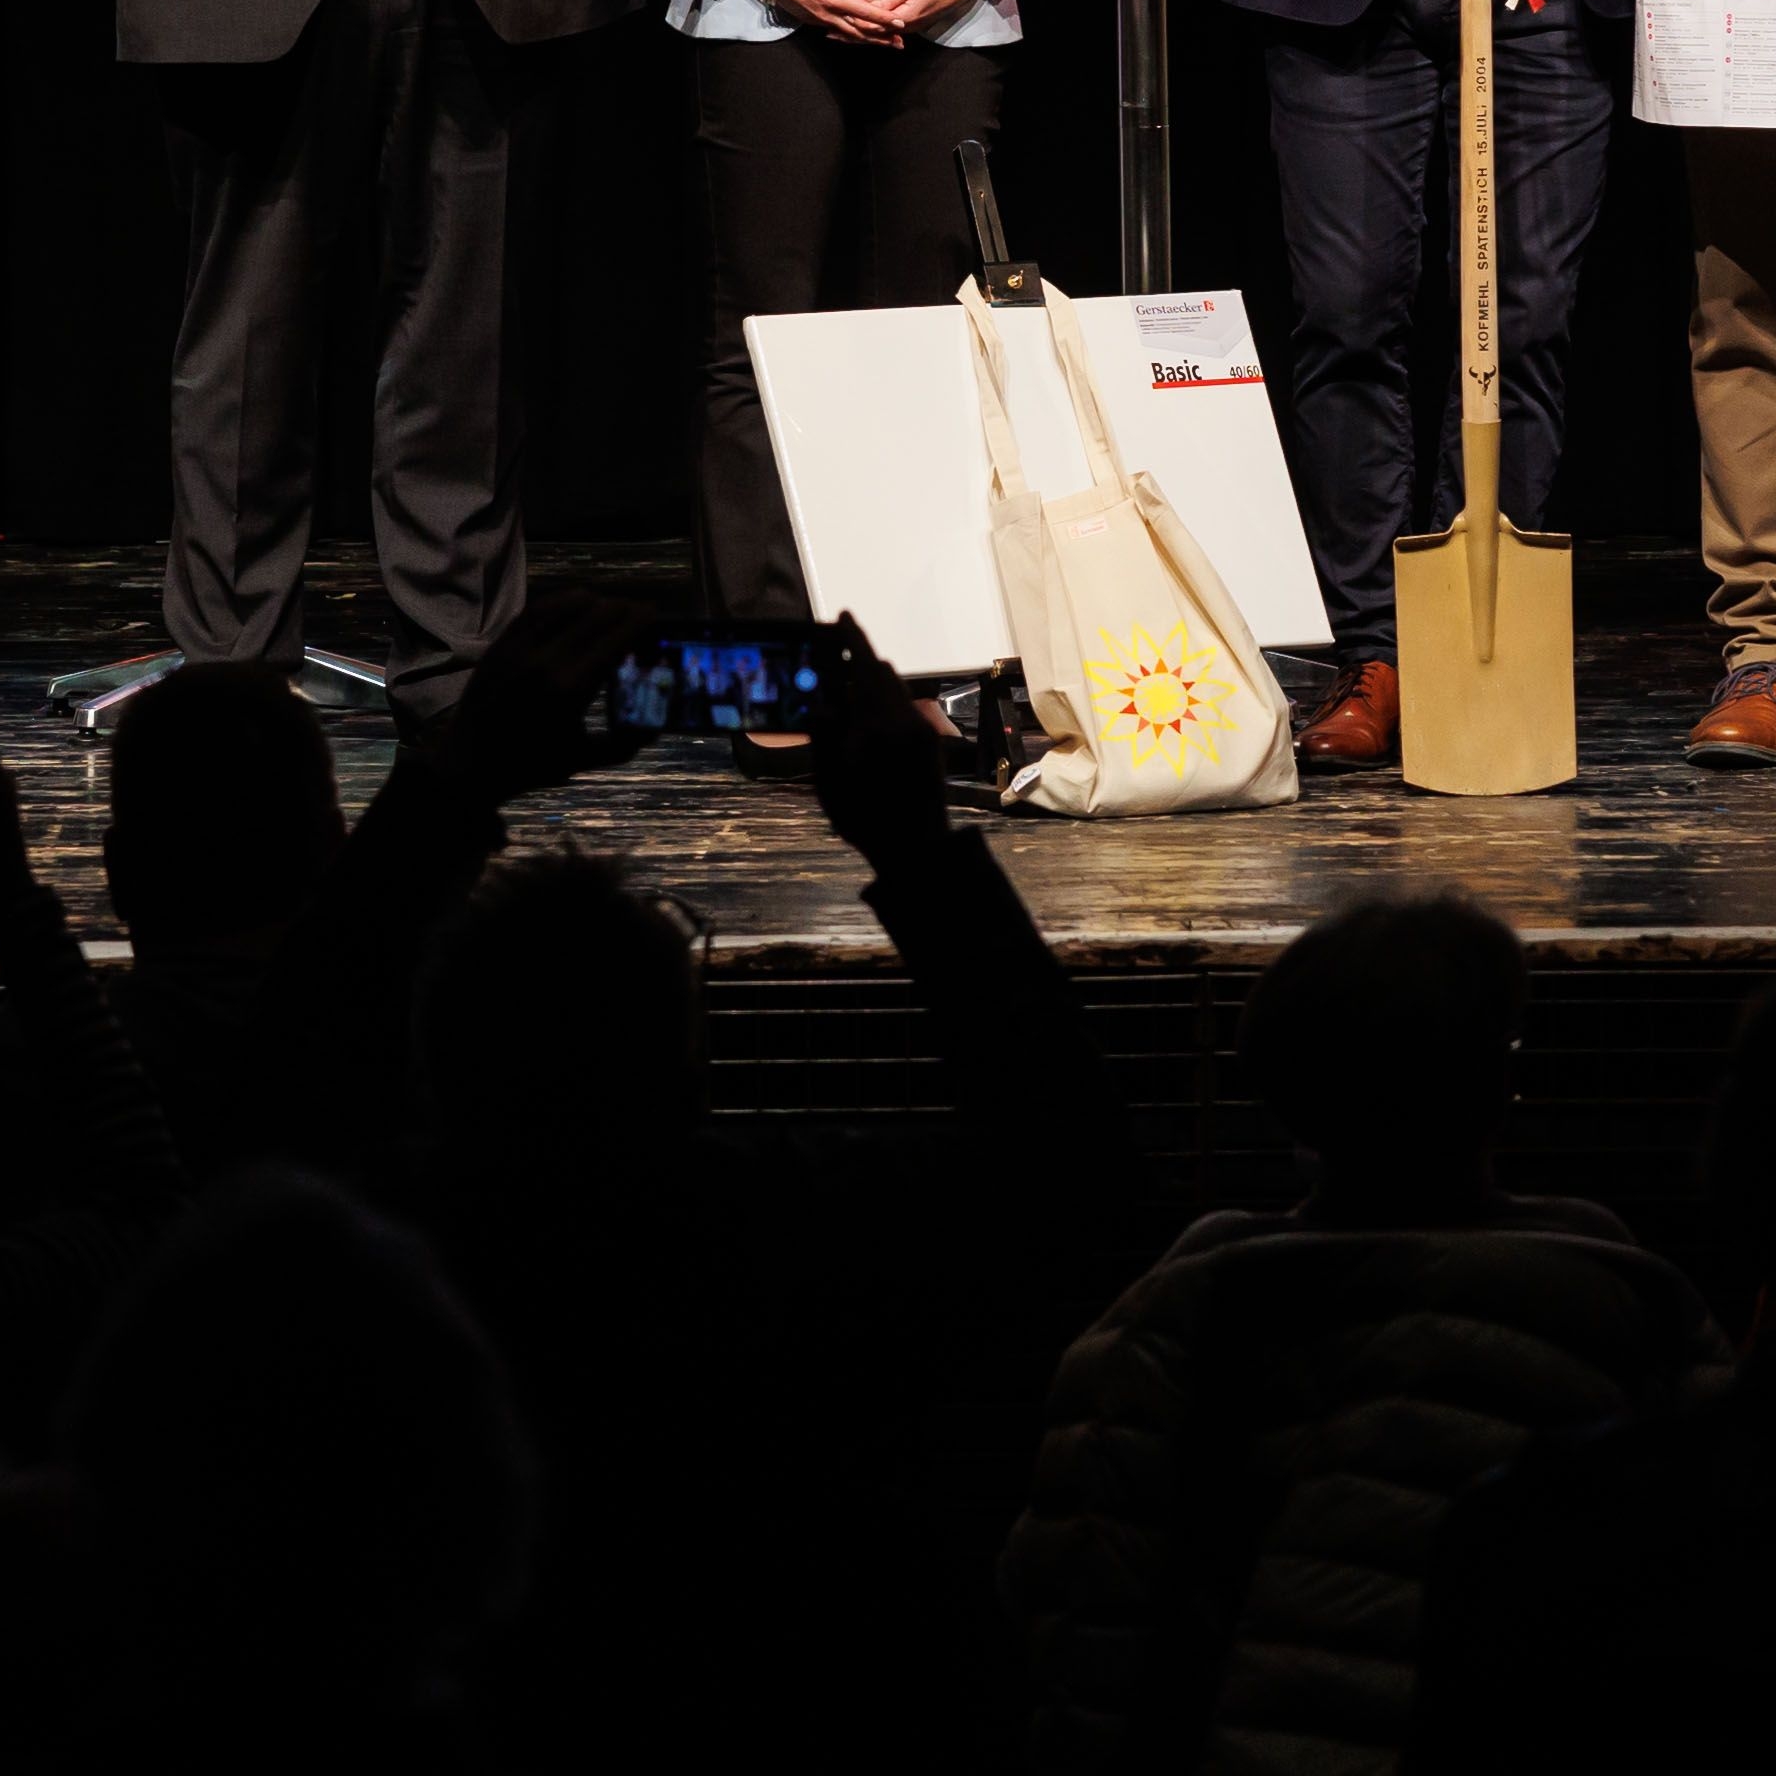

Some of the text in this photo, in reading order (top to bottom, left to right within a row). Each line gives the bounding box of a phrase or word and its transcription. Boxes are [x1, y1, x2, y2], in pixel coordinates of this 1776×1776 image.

[1476, 57, 1487, 93] 2004
[1476, 167, 1489, 271] SPATENSTICH
[1135, 301, 1203, 316] Gerstaecker
[1477, 281, 1490, 352] KOFMEHL
[1150, 359, 1261, 383] Basic 40/60
